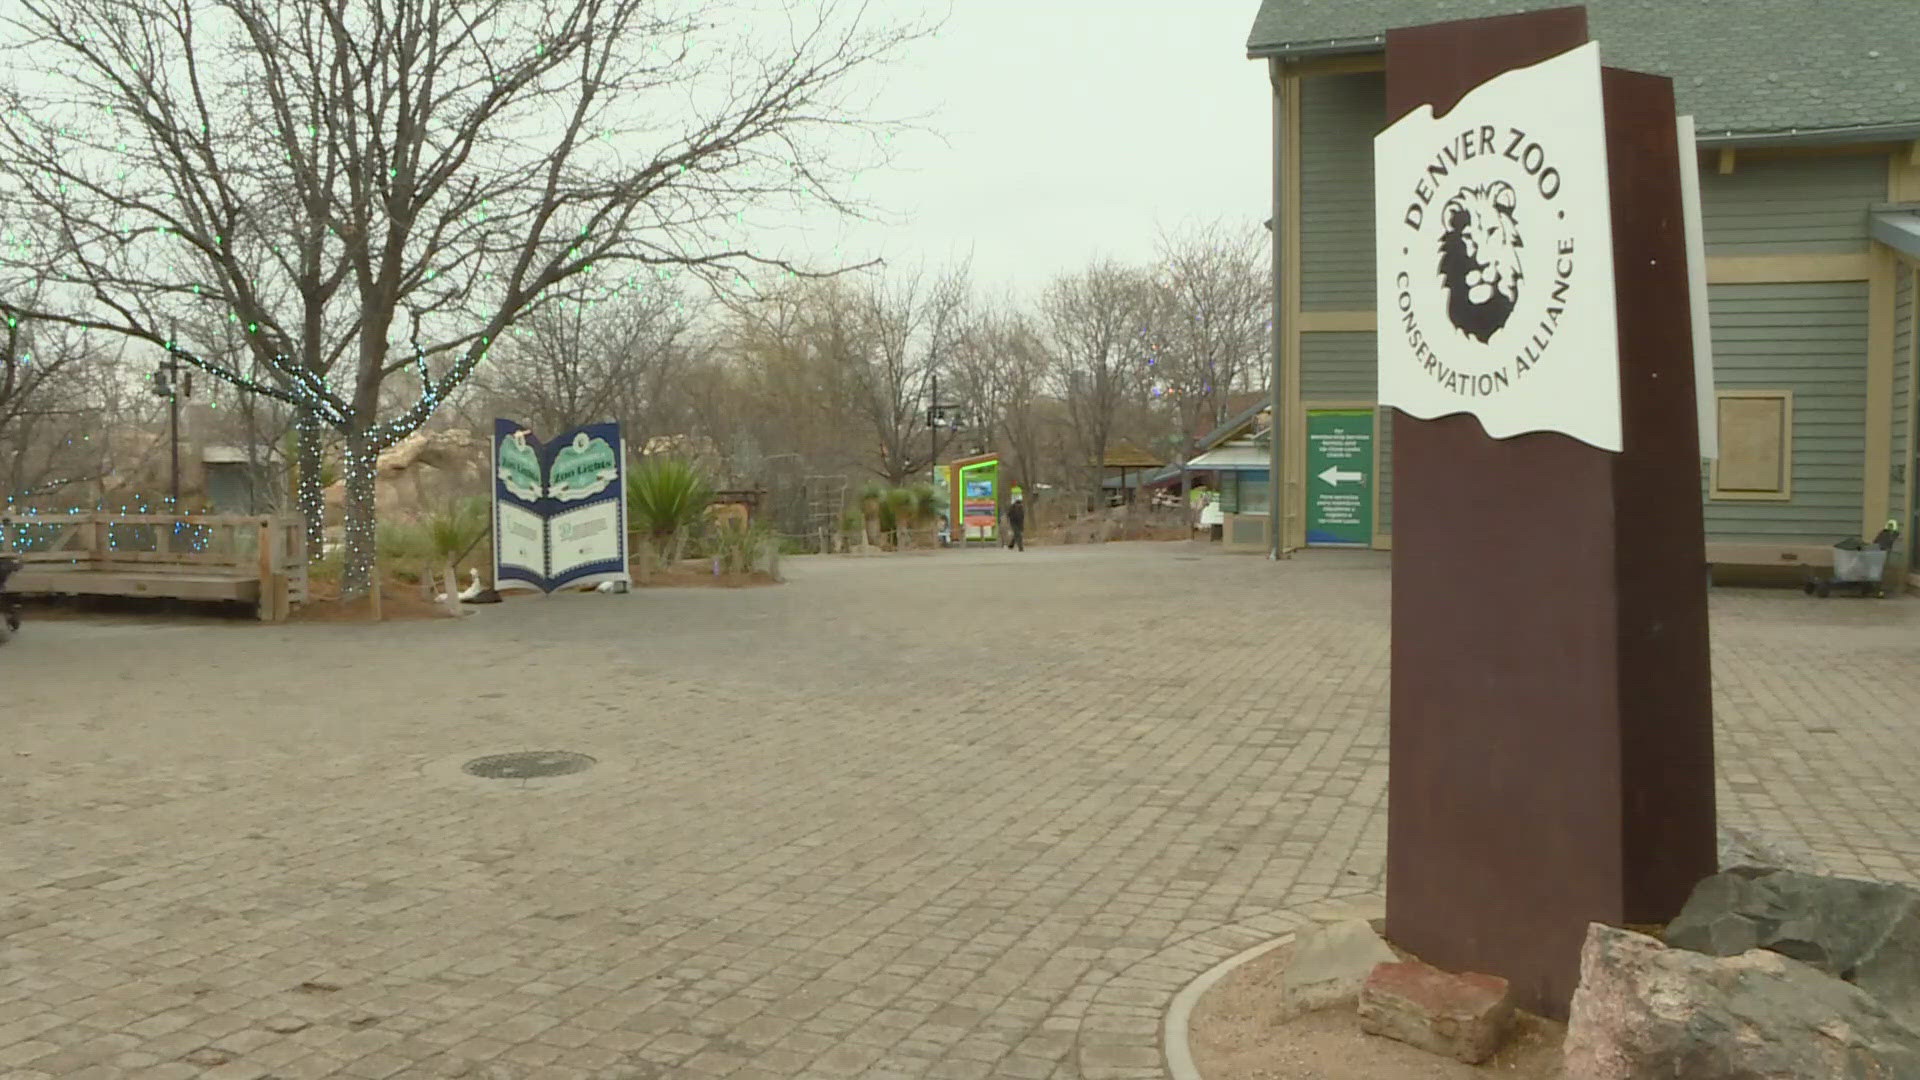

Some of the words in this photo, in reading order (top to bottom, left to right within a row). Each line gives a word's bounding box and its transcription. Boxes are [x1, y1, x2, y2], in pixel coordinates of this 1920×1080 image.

[1403, 125, 1497, 232] DENVER
[1502, 127, 1561, 201] ZOO
[1396, 271, 1510, 397] CONSERVATION
[1515, 236, 1575, 379] ALLIANCE
[554, 470, 576, 484] Zoo
[577, 459, 612, 475] Lights
